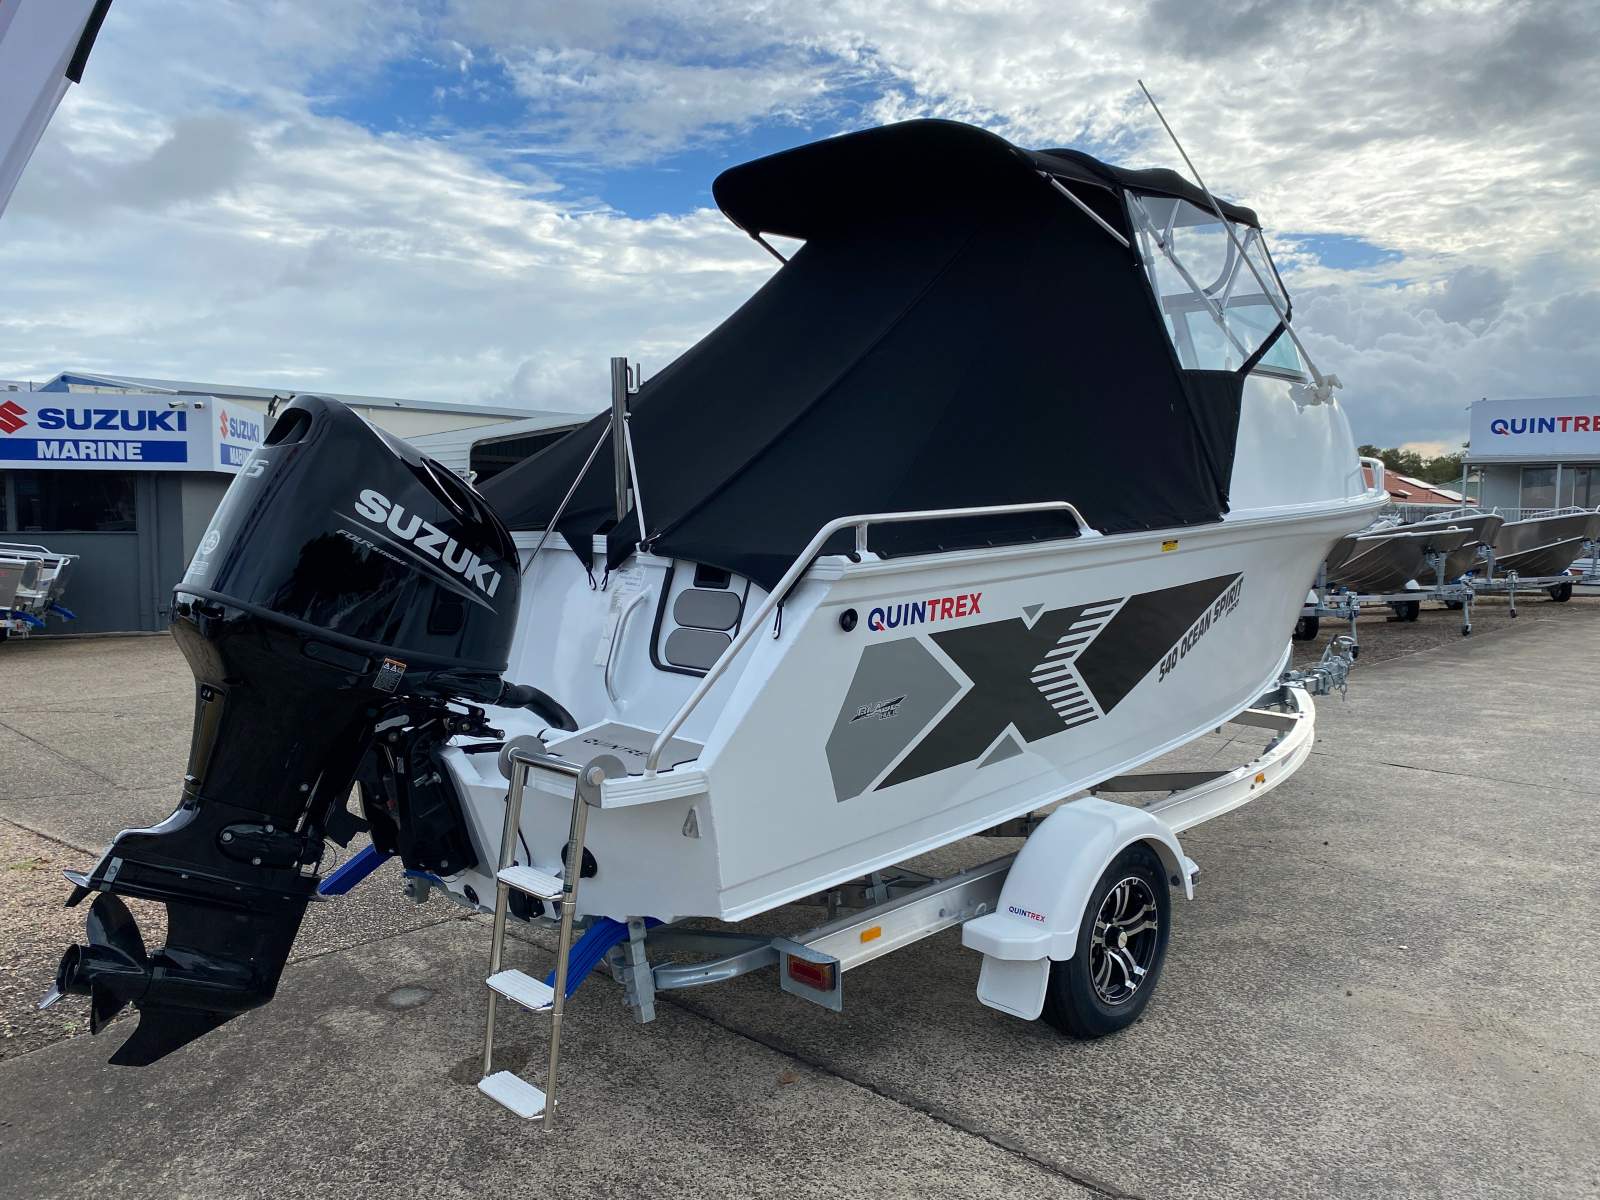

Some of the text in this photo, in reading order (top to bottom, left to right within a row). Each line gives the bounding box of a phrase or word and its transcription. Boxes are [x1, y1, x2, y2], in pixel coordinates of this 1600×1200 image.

[37, 407, 187, 432] SUZUKI
[229, 416, 260, 443] SUZUKI
[37, 441, 143, 460] MARINE
[354, 488, 502, 599] SUZUKI
[867, 592, 983, 632] QUINTREX
[1158, 646, 1179, 683] 540
[1181, 609, 1213, 660] OCEAN
[1213, 576, 1245, 624] SPIRIT
[1008, 905, 1046, 923] QUINTREX
